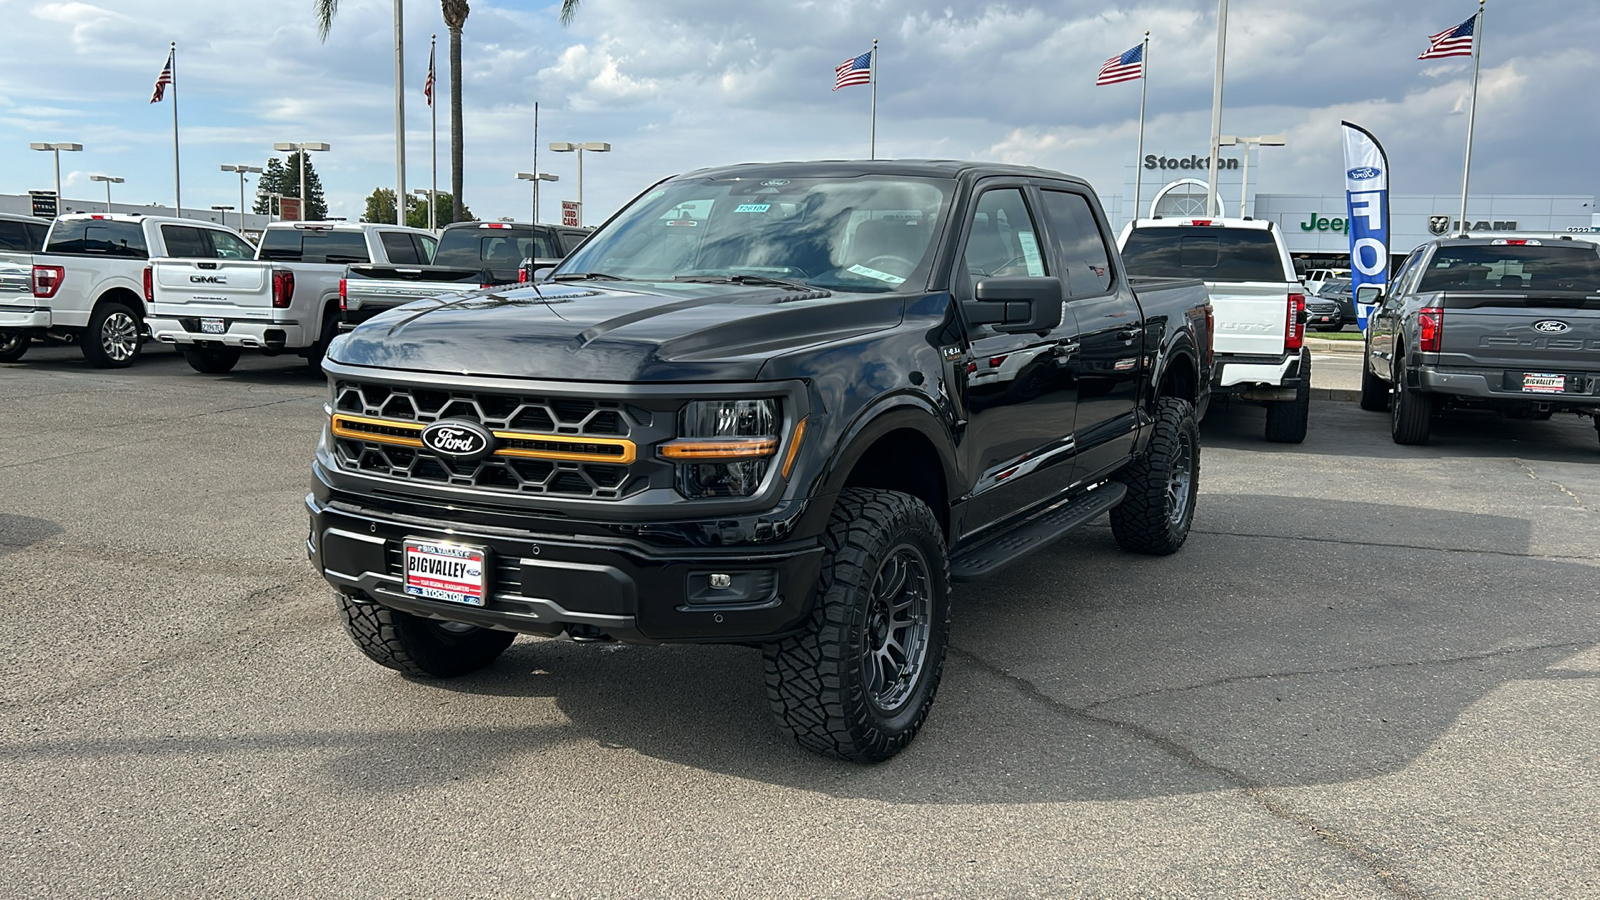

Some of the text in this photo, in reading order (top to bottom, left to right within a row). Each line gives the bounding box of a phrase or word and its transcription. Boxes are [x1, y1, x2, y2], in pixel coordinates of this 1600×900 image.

[564, 210, 576, 218] USED
[563, 218, 578, 227] CARS
[1453, 221, 1518, 231] RAM
[189, 275, 227, 284] GMC
[1540, 321, 1563, 331] Ford
[1525, 378, 1556, 386] BIGVALLEY
[434, 427, 474, 452] Ford
[409, 556, 467, 579] BIGVALLEY
[423, 588, 464, 602] STOCKTON
